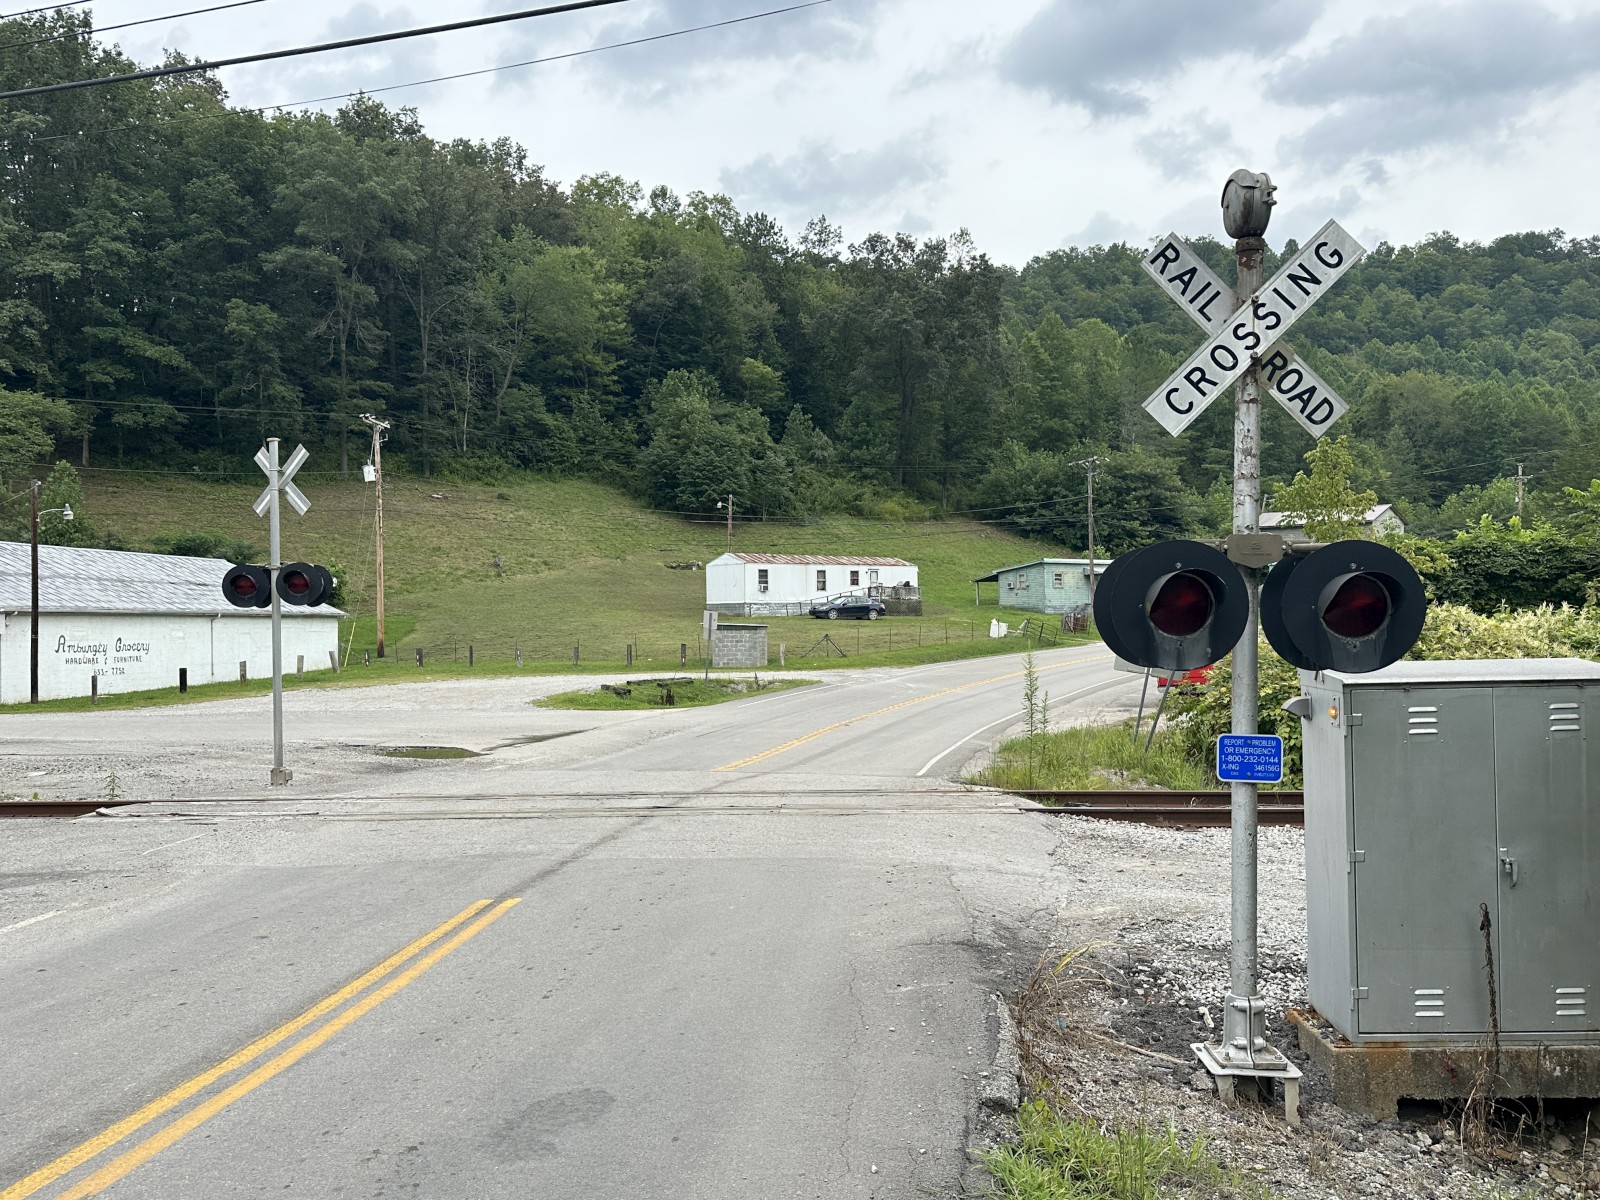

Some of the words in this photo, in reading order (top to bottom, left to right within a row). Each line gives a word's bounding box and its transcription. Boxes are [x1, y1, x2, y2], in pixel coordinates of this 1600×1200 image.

[1150, 242, 1221, 323] RAIL
[1165, 241, 1344, 415] CROSSING
[1261, 350, 1335, 426] ROAD
[55, 634, 108, 656] Amburgey
[115, 637, 150, 655] Grocery
[1221, 755, 1279, 763] 1-800-232-0144
